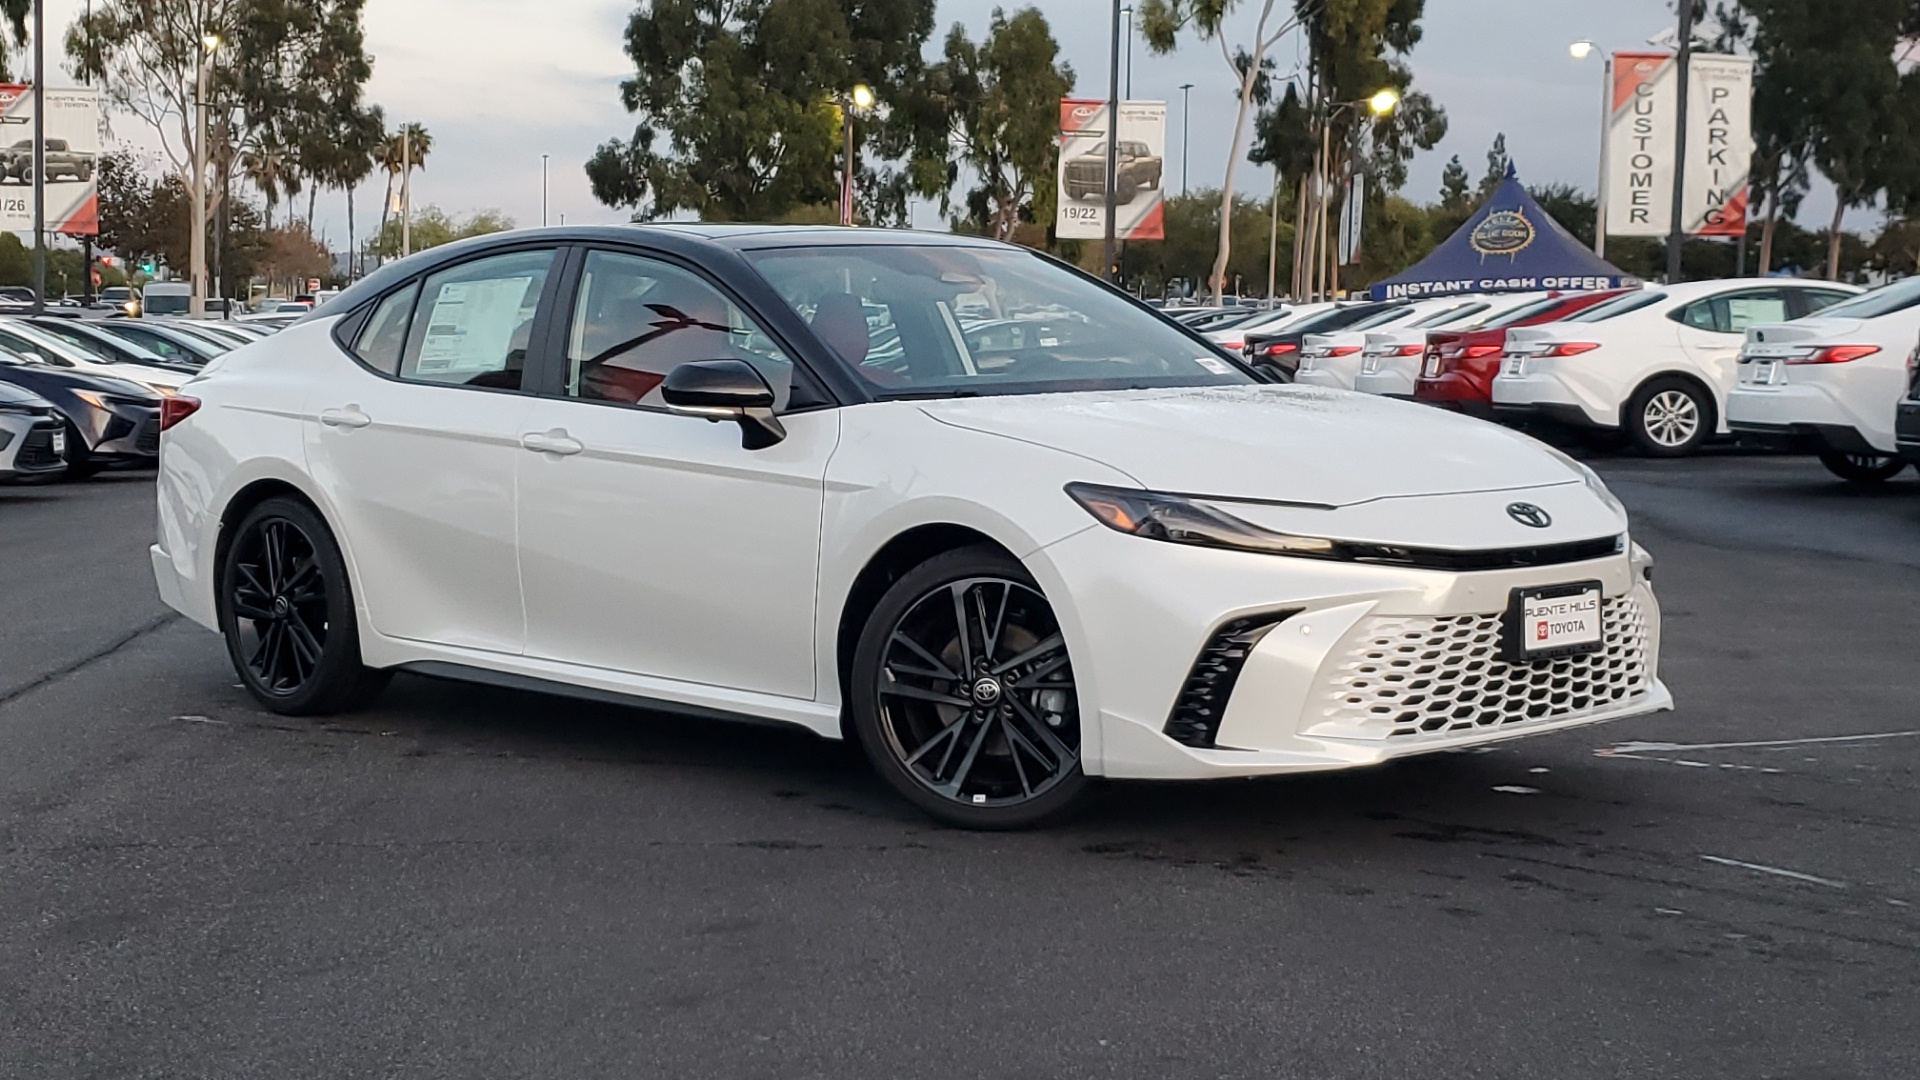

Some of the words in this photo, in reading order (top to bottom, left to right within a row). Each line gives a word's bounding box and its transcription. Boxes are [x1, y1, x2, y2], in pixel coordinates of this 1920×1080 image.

[1630, 82, 1654, 223] CUSTOMER
[1704, 87, 1730, 225] PARKING
[1062, 207, 1097, 219] 19/22
[1477, 230, 1501, 239] BLUE
[1502, 229, 1527, 239] BOOK
[1386, 280, 1472, 299] INSTANT
[1479, 277, 1537, 289] CASH
[1542, 277, 1610, 290] OFFER
[1525, 604, 1566, 618] PUENTE
[1570, 600, 1596, 613] HILLS
[1550, 620, 1585, 635] TOYOTA
